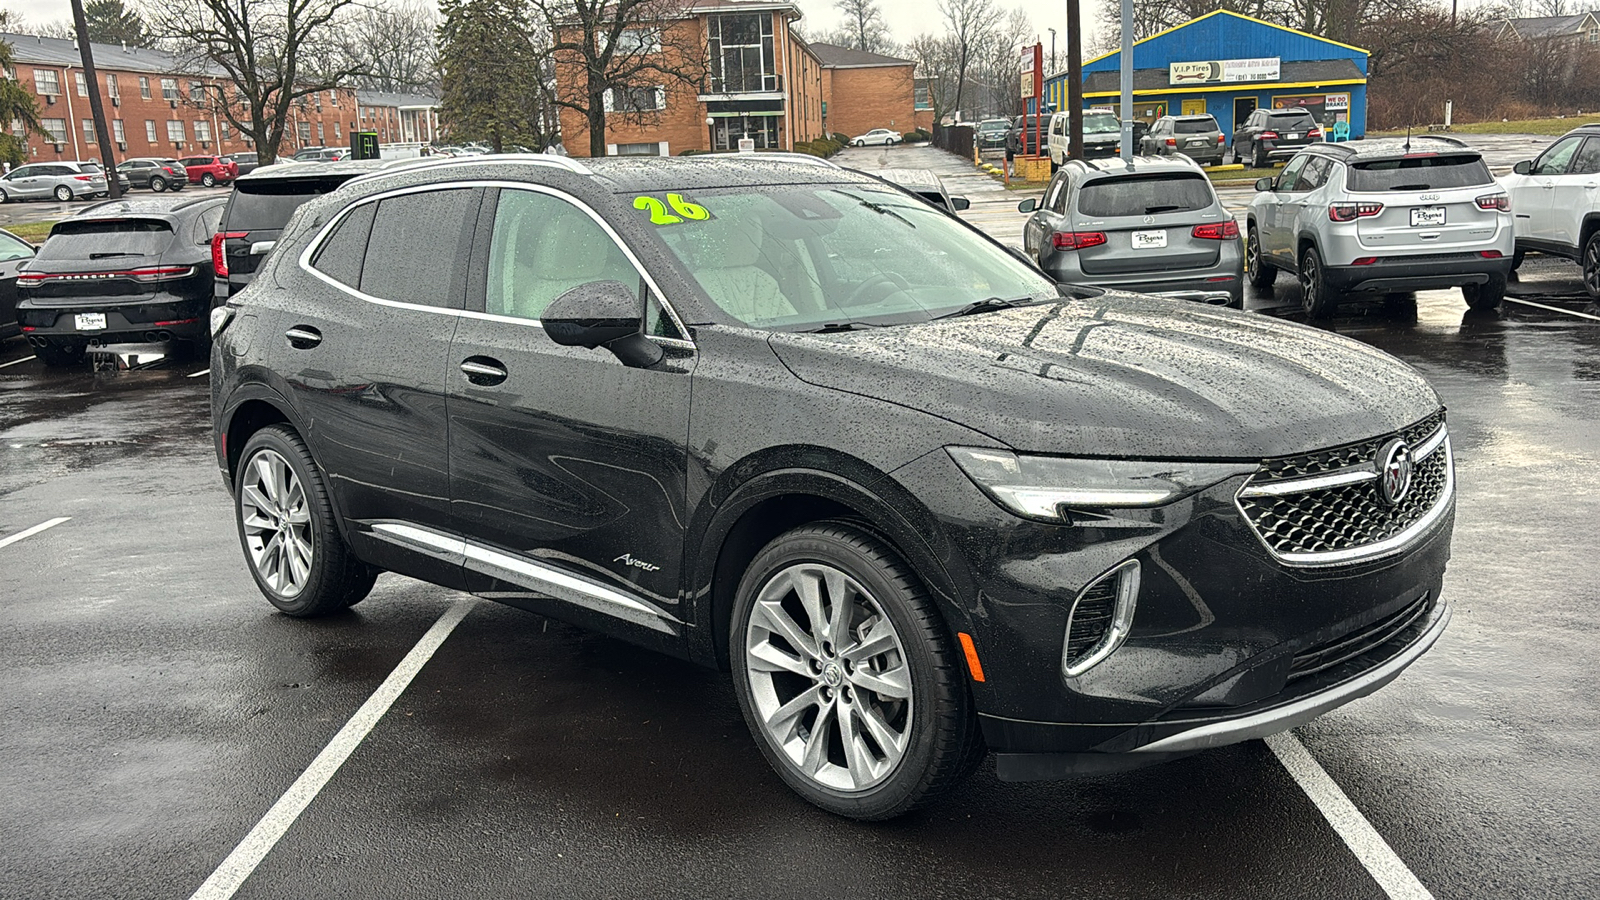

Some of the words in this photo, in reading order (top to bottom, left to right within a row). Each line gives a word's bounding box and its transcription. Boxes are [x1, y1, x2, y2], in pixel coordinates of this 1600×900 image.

[1174, 65, 1190, 73] V.I.P
[1192, 64, 1210, 72] Tires
[633, 193, 710, 225] 26
